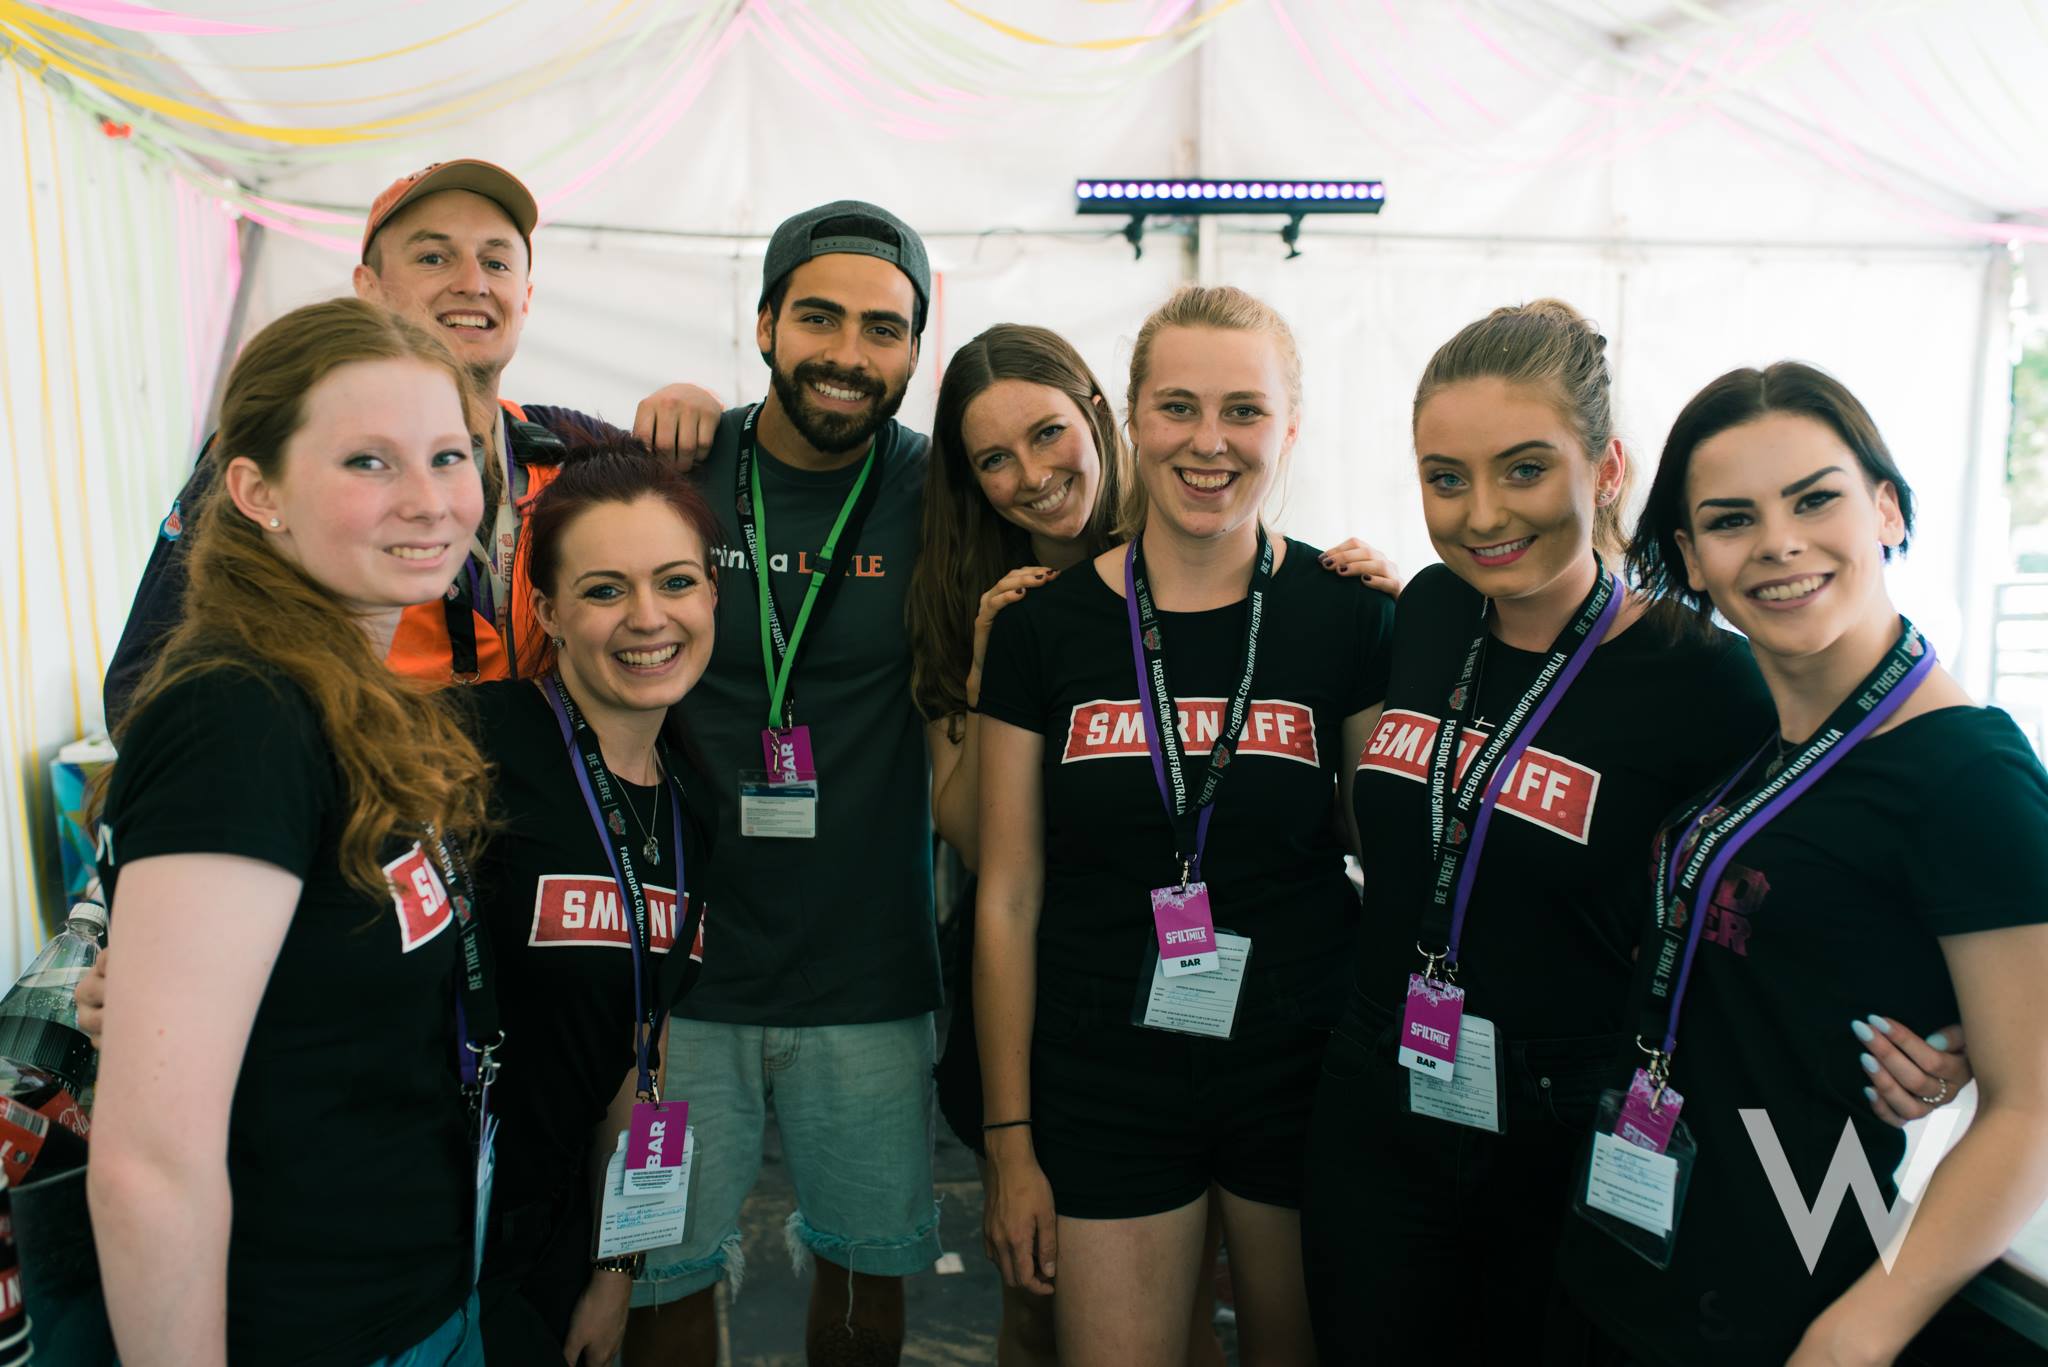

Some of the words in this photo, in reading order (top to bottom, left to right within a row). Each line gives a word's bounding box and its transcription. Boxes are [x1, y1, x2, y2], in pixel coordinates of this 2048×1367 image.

[769, 553, 788, 573] a
[1136, 579, 1145, 593] BE
[1141, 591, 1153, 620] THERE
[1574, 621, 1592, 636] BE
[1584, 587, 1611, 622] THERE
[1226, 591, 1263, 740] FACEBOOK.COM/SMIRNOFFAUSTRALIA
[1858, 692, 1879, 713] BE
[1872, 656, 1909, 697] THERE
[1086, 711, 1296, 746] SMRNFF
[1152, 658, 1187, 816] FACEBOOK.COM/SMIRNOFFAUSTRALIA
[1458, 652, 1568, 811] FACEBOOK.COM/SMIRNOFFAUSTRALIA
[586, 753, 600, 768] BE
[781, 742, 797, 785] BAR
[590, 767, 613, 801] THERE
[1681, 728, 1844, 889] FACEBOOK.COM/SMIRNOFFAUSTRALIA
[1437, 854, 1458, 890] THERE
[1434, 889, 1447, 904] BE
[464, 932, 480, 973] THERE
[1180, 958, 1201, 968] BAR
[1657, 938, 1679, 981] THERE
[469, 971, 483, 990] BE
[1652, 979, 1667, 998] BE
[1416, 1056, 1437, 1070] BAR
[645, 1121, 666, 1169] BAR
